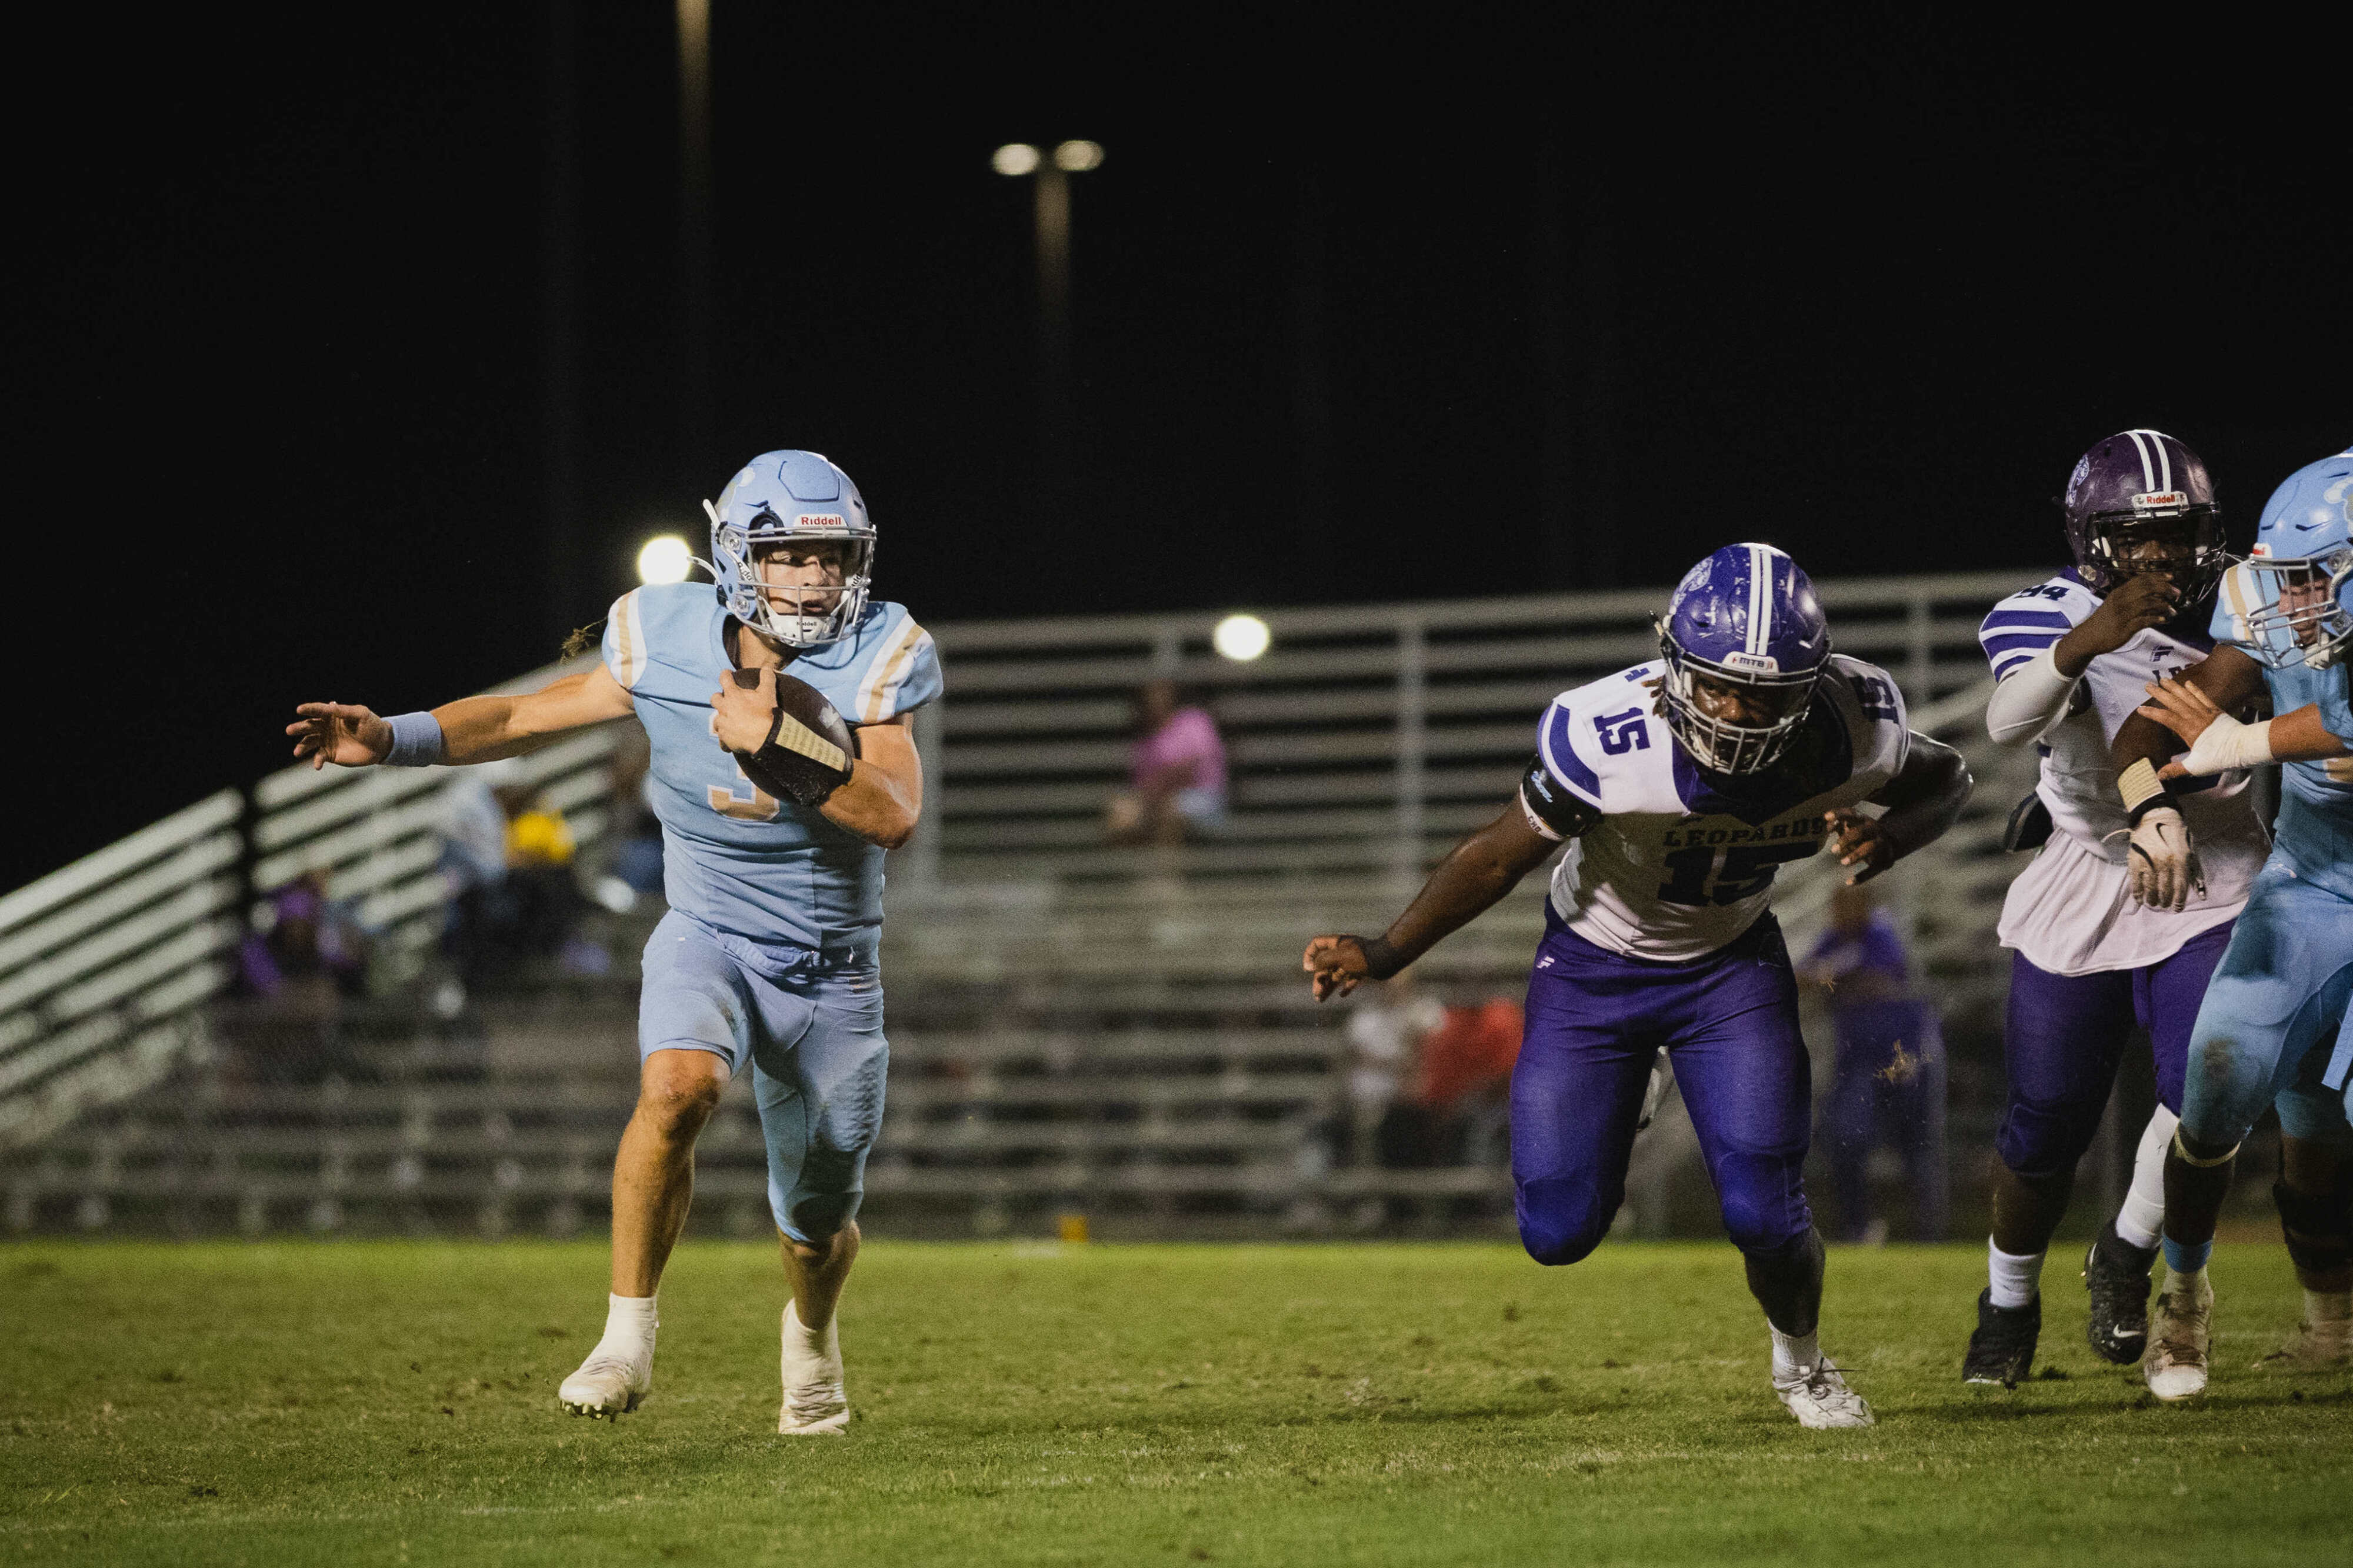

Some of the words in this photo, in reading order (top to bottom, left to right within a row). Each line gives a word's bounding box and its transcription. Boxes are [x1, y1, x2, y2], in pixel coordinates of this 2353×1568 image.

[2147, 494, 2175, 504] Riddell
[801, 516, 841, 525] Riddell
[1594, 707, 1651, 755] 15
[1658, 840, 1818, 906] 15
